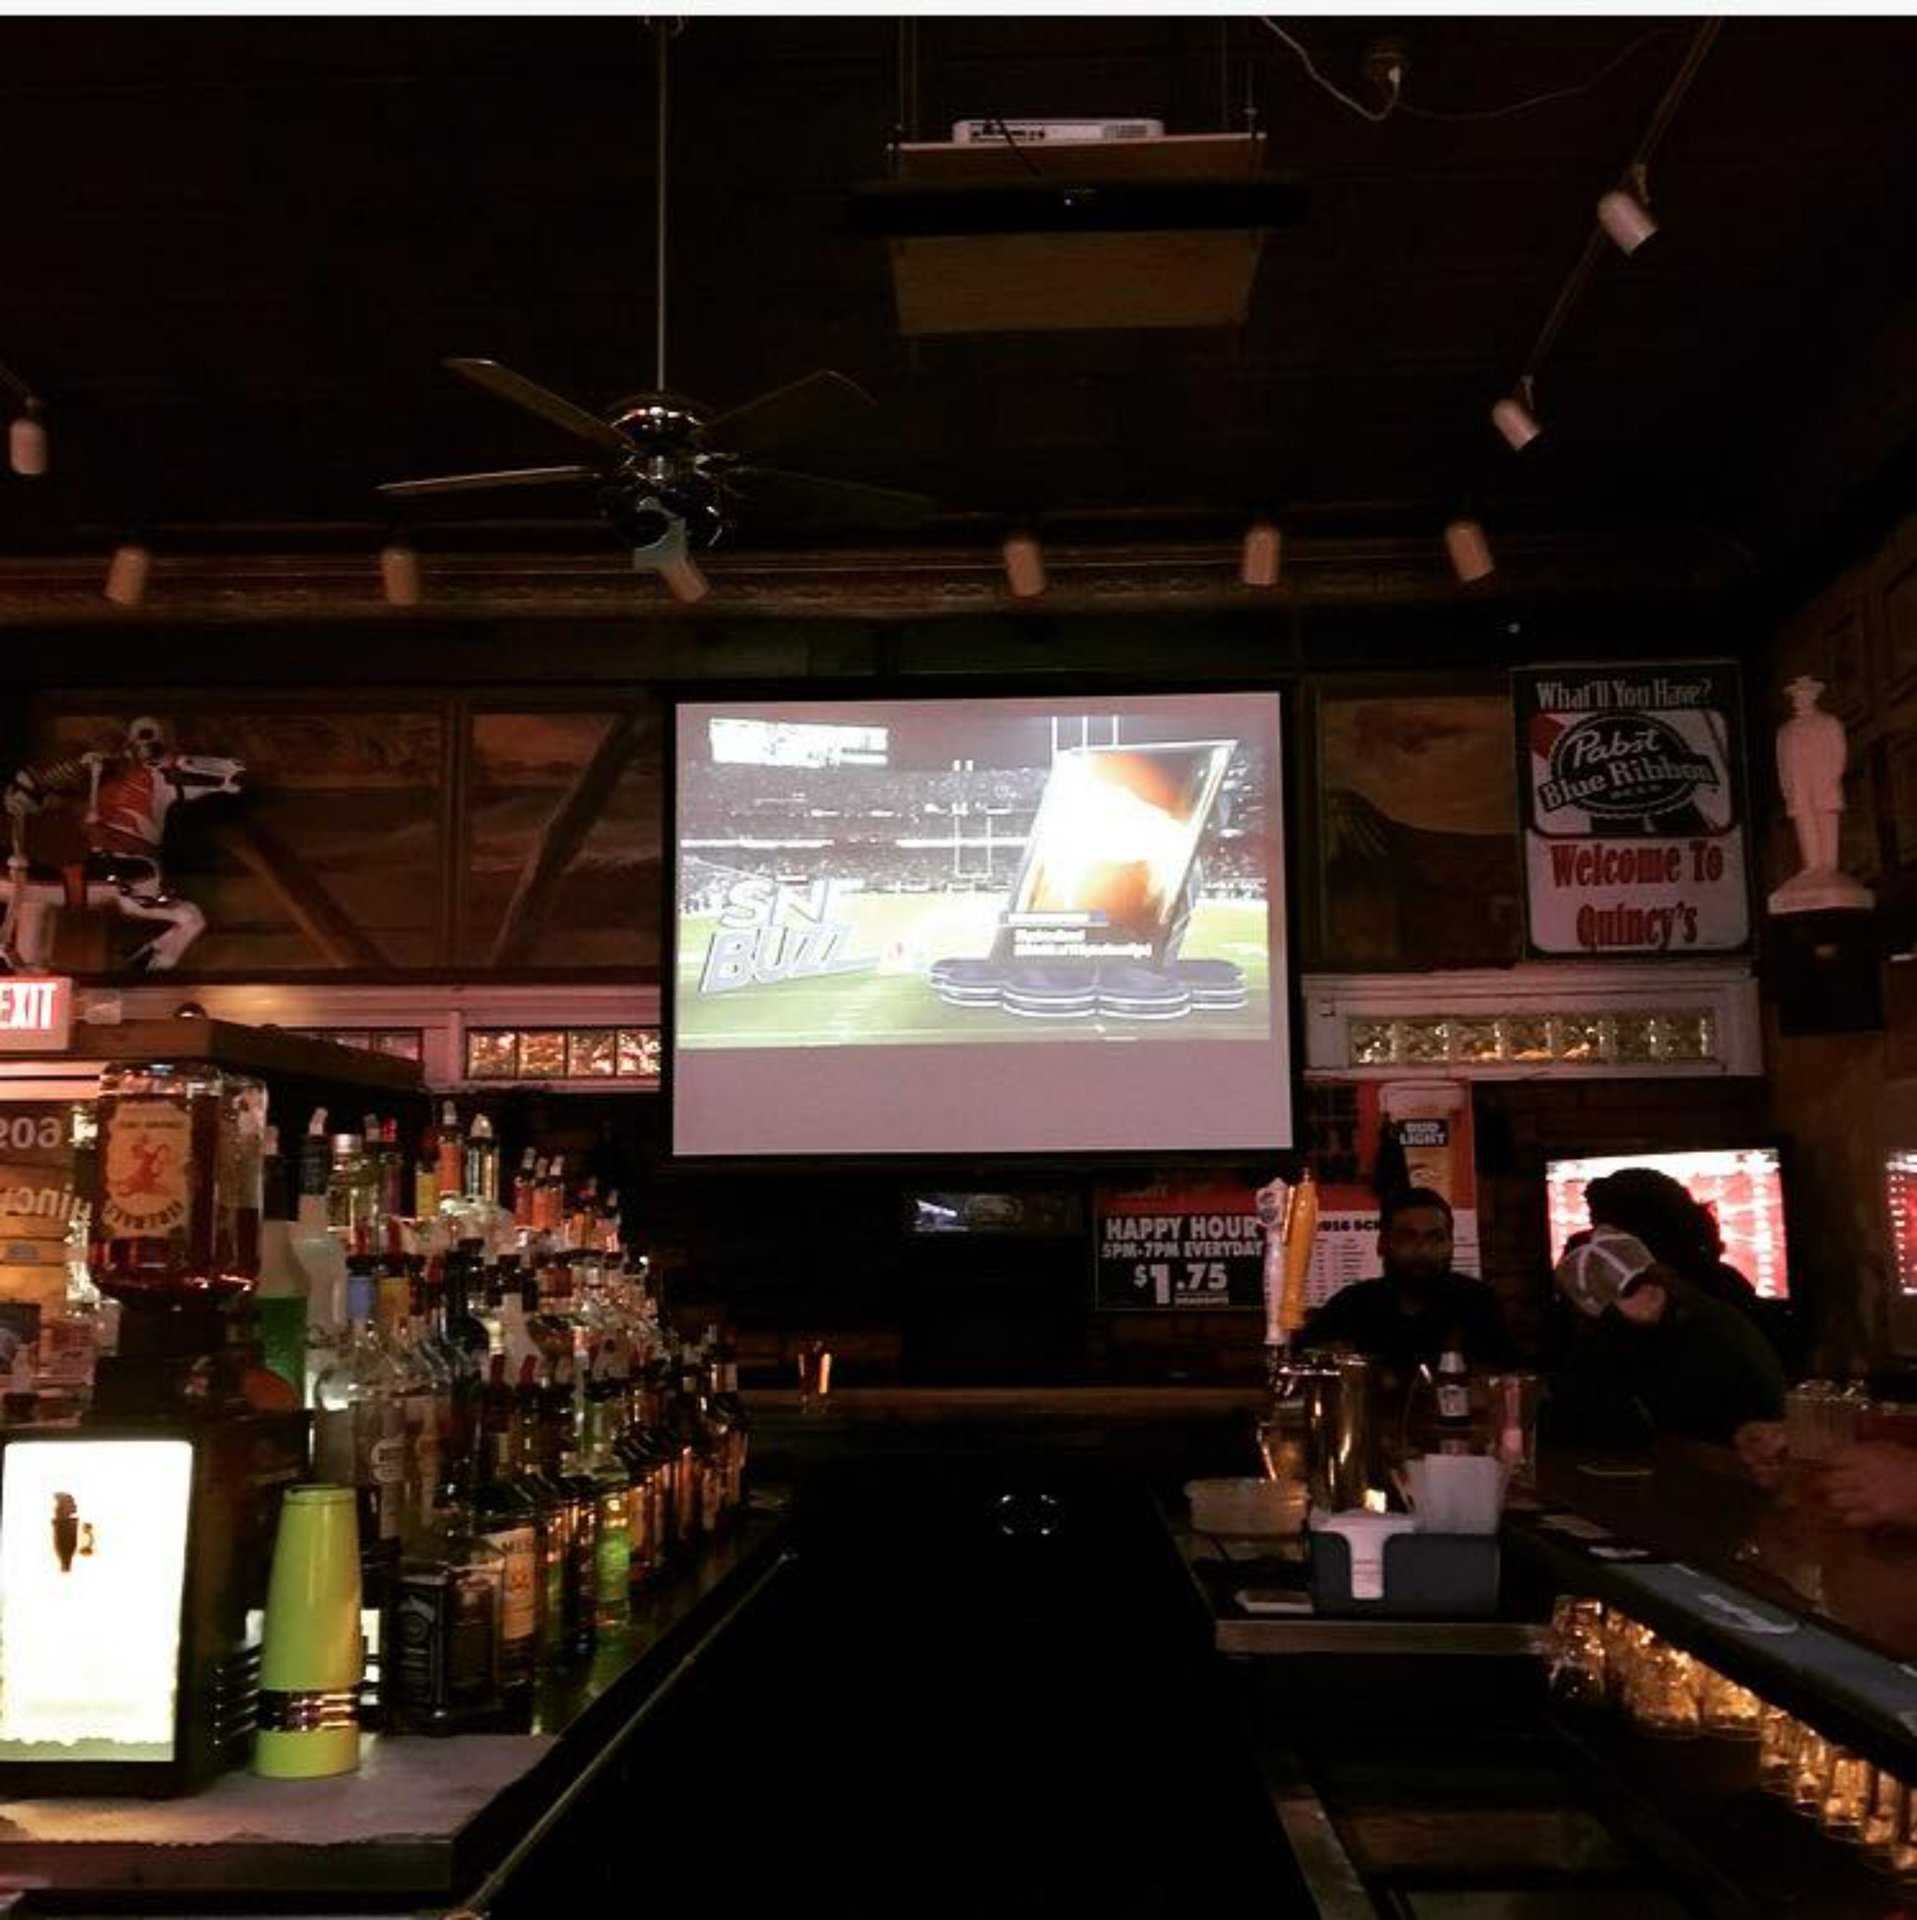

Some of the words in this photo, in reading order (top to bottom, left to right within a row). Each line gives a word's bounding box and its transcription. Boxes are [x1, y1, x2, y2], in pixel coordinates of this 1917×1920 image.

[1611, 679, 1651, 709] You
[1572, 729, 1661, 767] Pabst
[1541, 772, 1606, 809] Blue
[1607, 755, 1716, 788] Ribbon
[1551, 843, 1681, 888] Welcome
[1688, 841, 1724, 883] To
[1576, 901, 1698, 949] Quincy's
[0, 982, 57, 1030] EXIT
[1399, 1132, 1446, 1146] LIGHT
[1405, 1122, 1441, 1133] BUD
[1106, 1217, 1183, 1240] HAPPY
[1190, 1215, 1258, 1239] HOUR
[1184, 1241, 1263, 1258] EVERYDAY
[1133, 1262, 1228, 1305] $1.75
